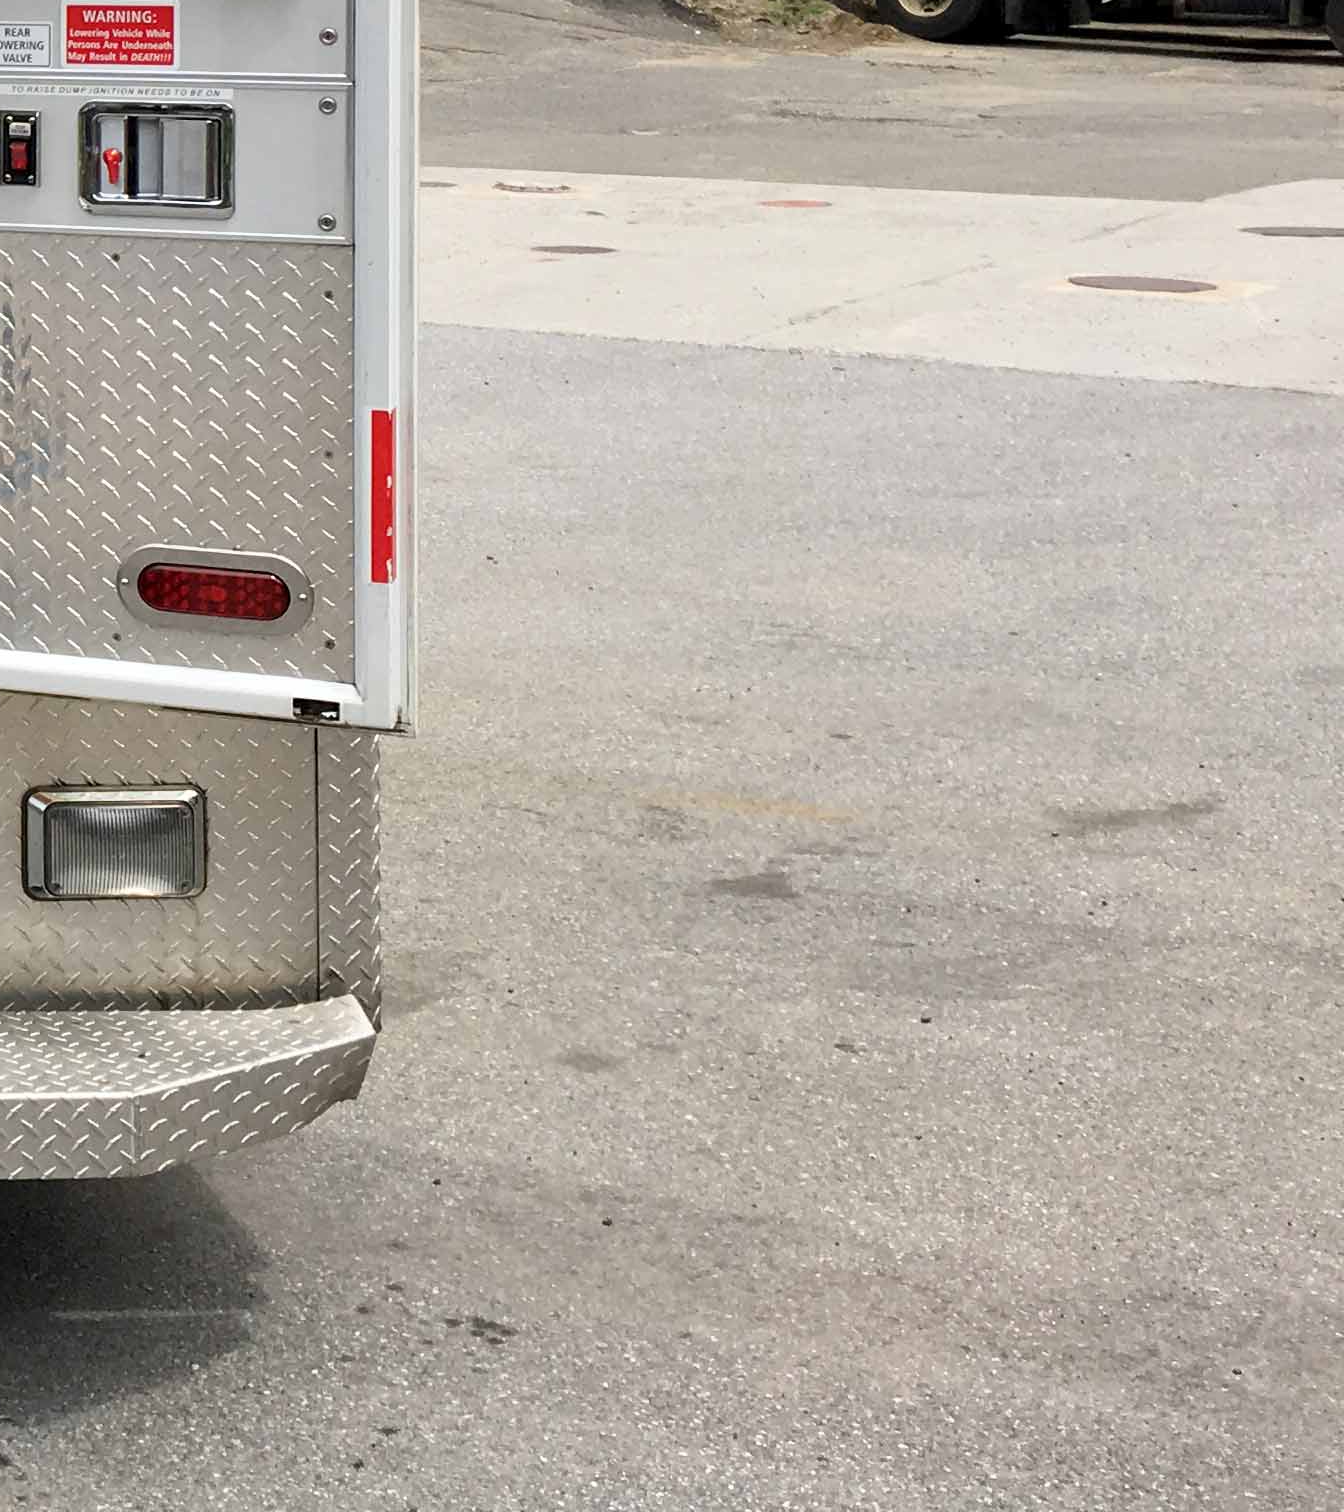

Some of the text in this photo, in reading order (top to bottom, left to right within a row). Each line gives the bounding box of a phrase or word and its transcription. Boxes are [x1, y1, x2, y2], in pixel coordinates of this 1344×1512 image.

[83, 10, 158, 24] WARNING:
[4, 27, 31, 37] REAR
[70, 29, 171, 39] Lowering Vehicle While
[68, 40, 173, 51] Persons Are Underneath
[2, 53, 33, 63] VALVE
[68, 52, 172, 63] May Result in DEATH!!!
[11, 85, 25, 94] TO
[27, 86, 57, 94] RAISE
[138, 88, 171, 97] NEEDS
[175, 89, 188, 97] TO
[190, 89, 204, 97] BE
[206, 89, 221, 98] ON
